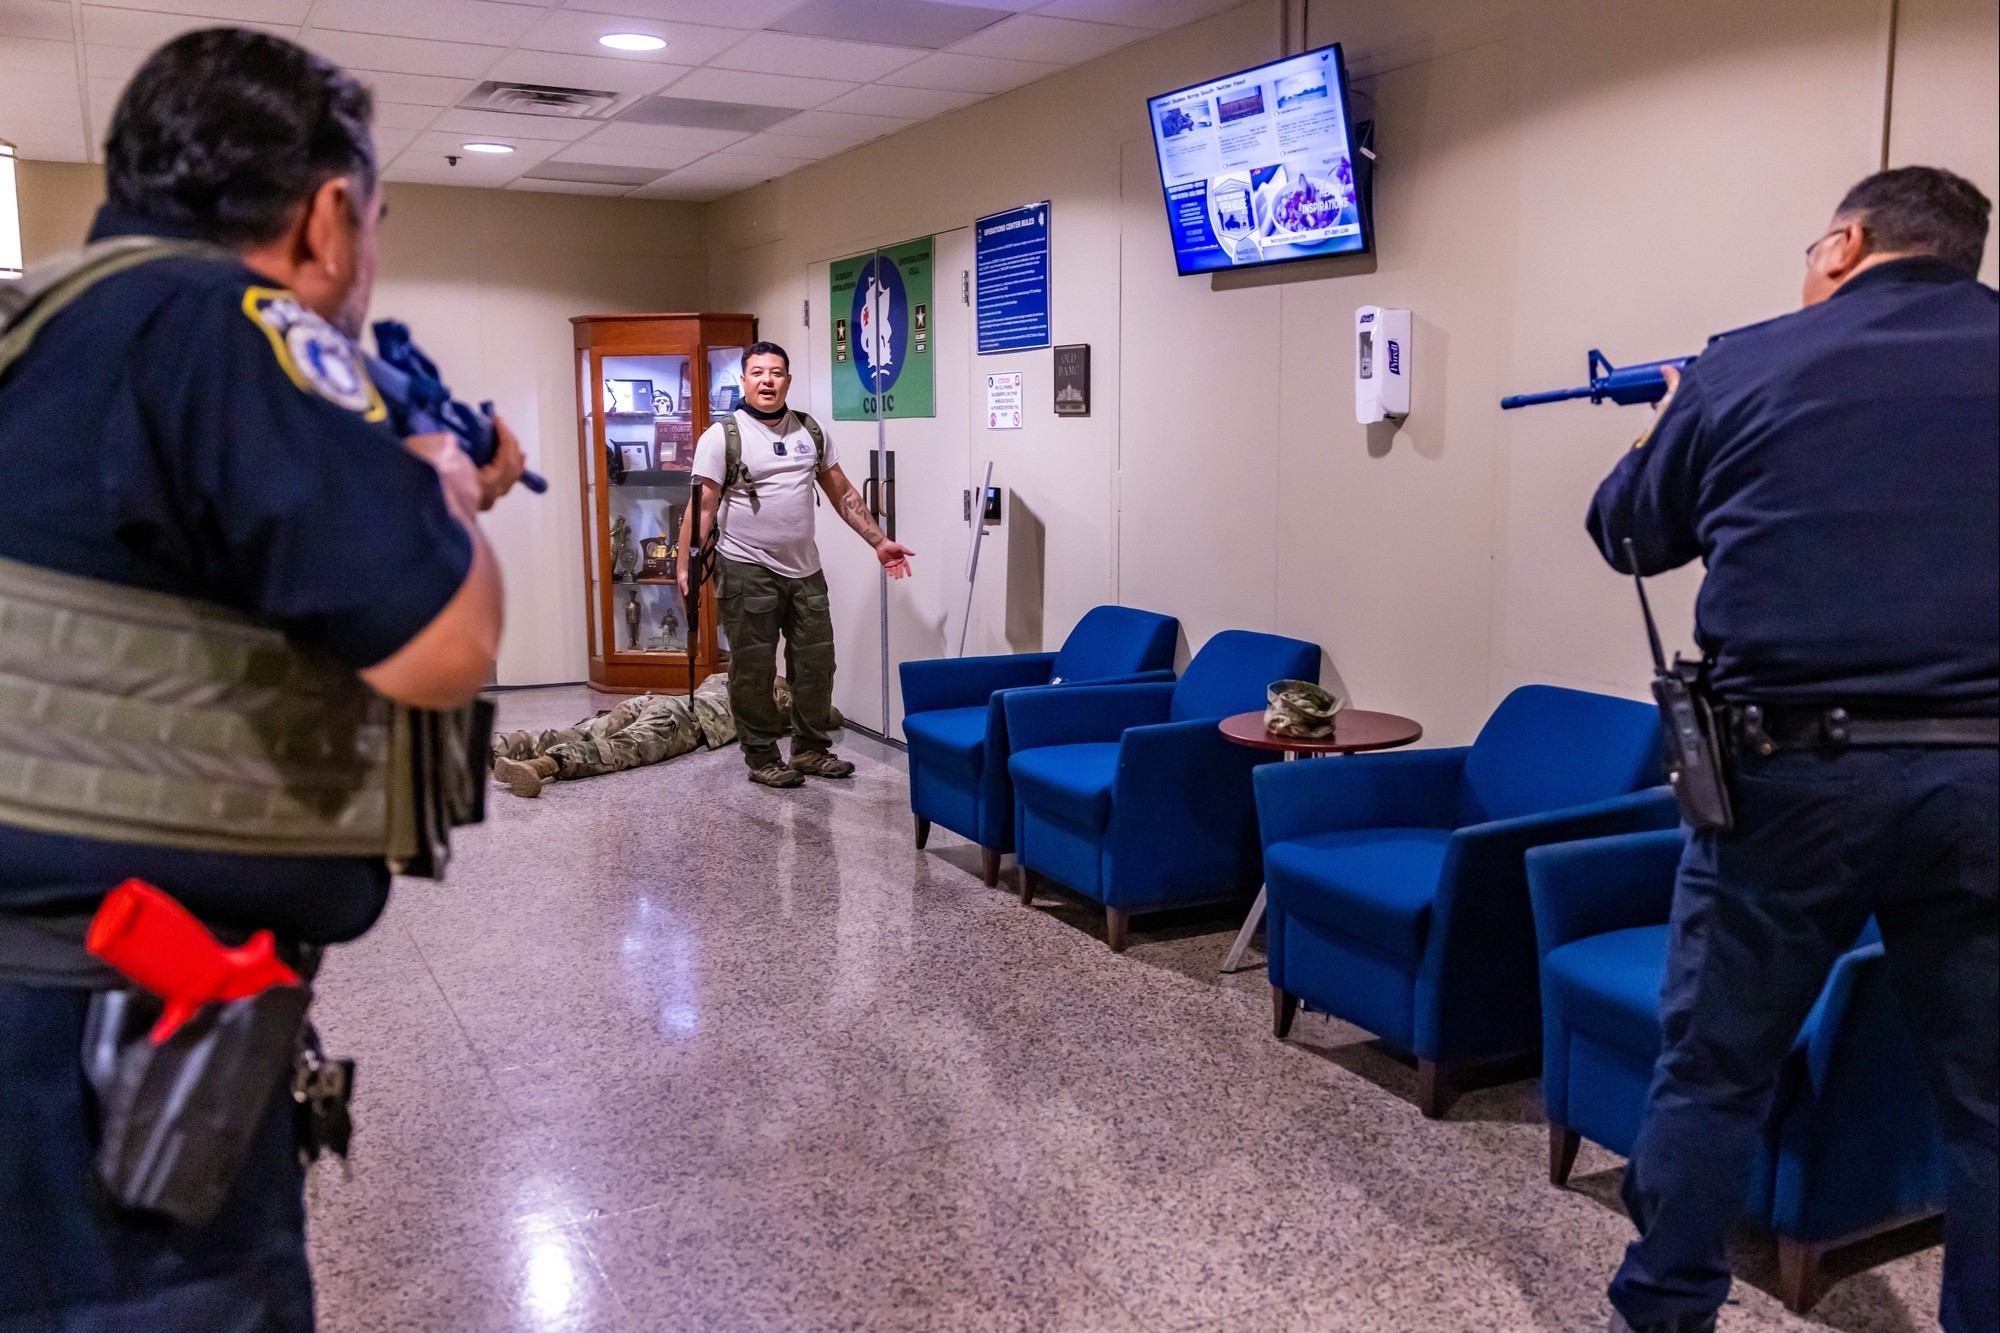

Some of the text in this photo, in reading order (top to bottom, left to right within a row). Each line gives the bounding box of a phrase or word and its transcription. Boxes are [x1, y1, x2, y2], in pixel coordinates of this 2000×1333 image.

[1156, 100, 1171, 109] United
[1171, 96, 1185, 105] States
[1187, 92, 1199, 100] Army
[1200, 88, 1215, 96] South
[1302, 196, 1348, 214] INSPIRATIONS
[1006, 220, 1021, 231] CENTER
[1021, 217, 1035, 227] RULES
[1061, 352, 1077, 364] OLD
